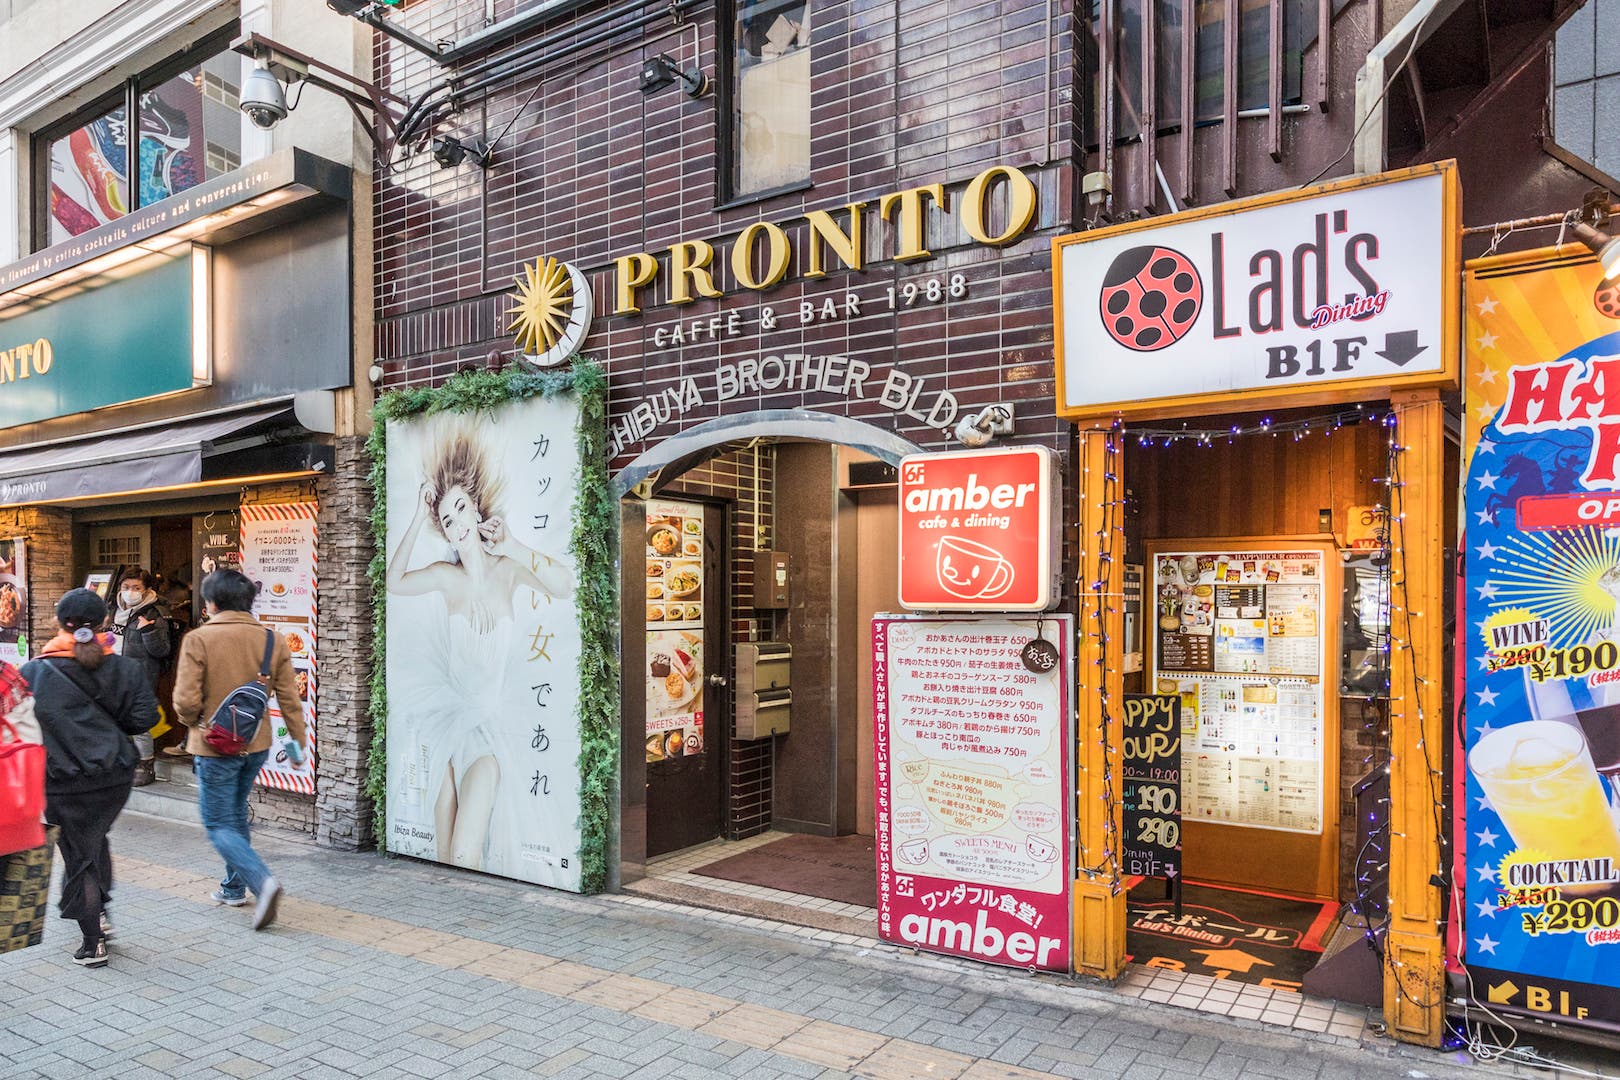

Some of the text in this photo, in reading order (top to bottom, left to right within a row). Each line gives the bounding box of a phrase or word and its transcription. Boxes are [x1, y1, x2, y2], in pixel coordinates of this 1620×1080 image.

[9, 259, 40, 279] flavored
[43, 257, 52, 268] by
[132, 212, 166, 233] culture
[172, 200, 190, 217] and
[613, 165, 1037, 315] PRONTO
[1211, 209, 1380, 340] Lad's
[654, 272, 968, 348] CAFFÈ & BAR 1988
[1311, 289, 1393, 332] Dining
[1265, 336, 1368, 380] B1F
[715, 353, 871, 402] BROTHER
[12, 480, 47, 497] PRONTO
[905, 473, 1036, 513] amber
[918, 513, 1011, 529] cafe & dining
[528, 433, 555, 797] カッコいい女であれ
[1491, 619, 1549, 649] WINE
[1531, 642, 1618, 683] ¥190
[1000, 687, 1023, 697] 680円
[1013, 675, 1037, 685] 580円
[1013, 713, 1037, 723] 650円
[1019, 700, 1044, 711] 950円
[646, 718, 673, 731] SWEETS
[937, 720, 959, 731] 380円
[1017, 725, 1041, 737] 750円
[1003, 746, 1027, 758] 750円
[1150, 767, 1180, 782] 19:00
[1138, 785, 1177, 815] 190
[394, 823, 435, 843] Ibiza Beauty
[954, 838, 1017, 854] SWEETS MENU
[1137, 816, 1179, 849] 290
[1131, 859, 1161, 876] B1F
[1508, 858, 1617, 886] COCKTAIL
[1523, 899, 1619, 934] ¥290
[899, 909, 1062, 967] amber
[1133, 918, 1226, 945] Lad's Dining
